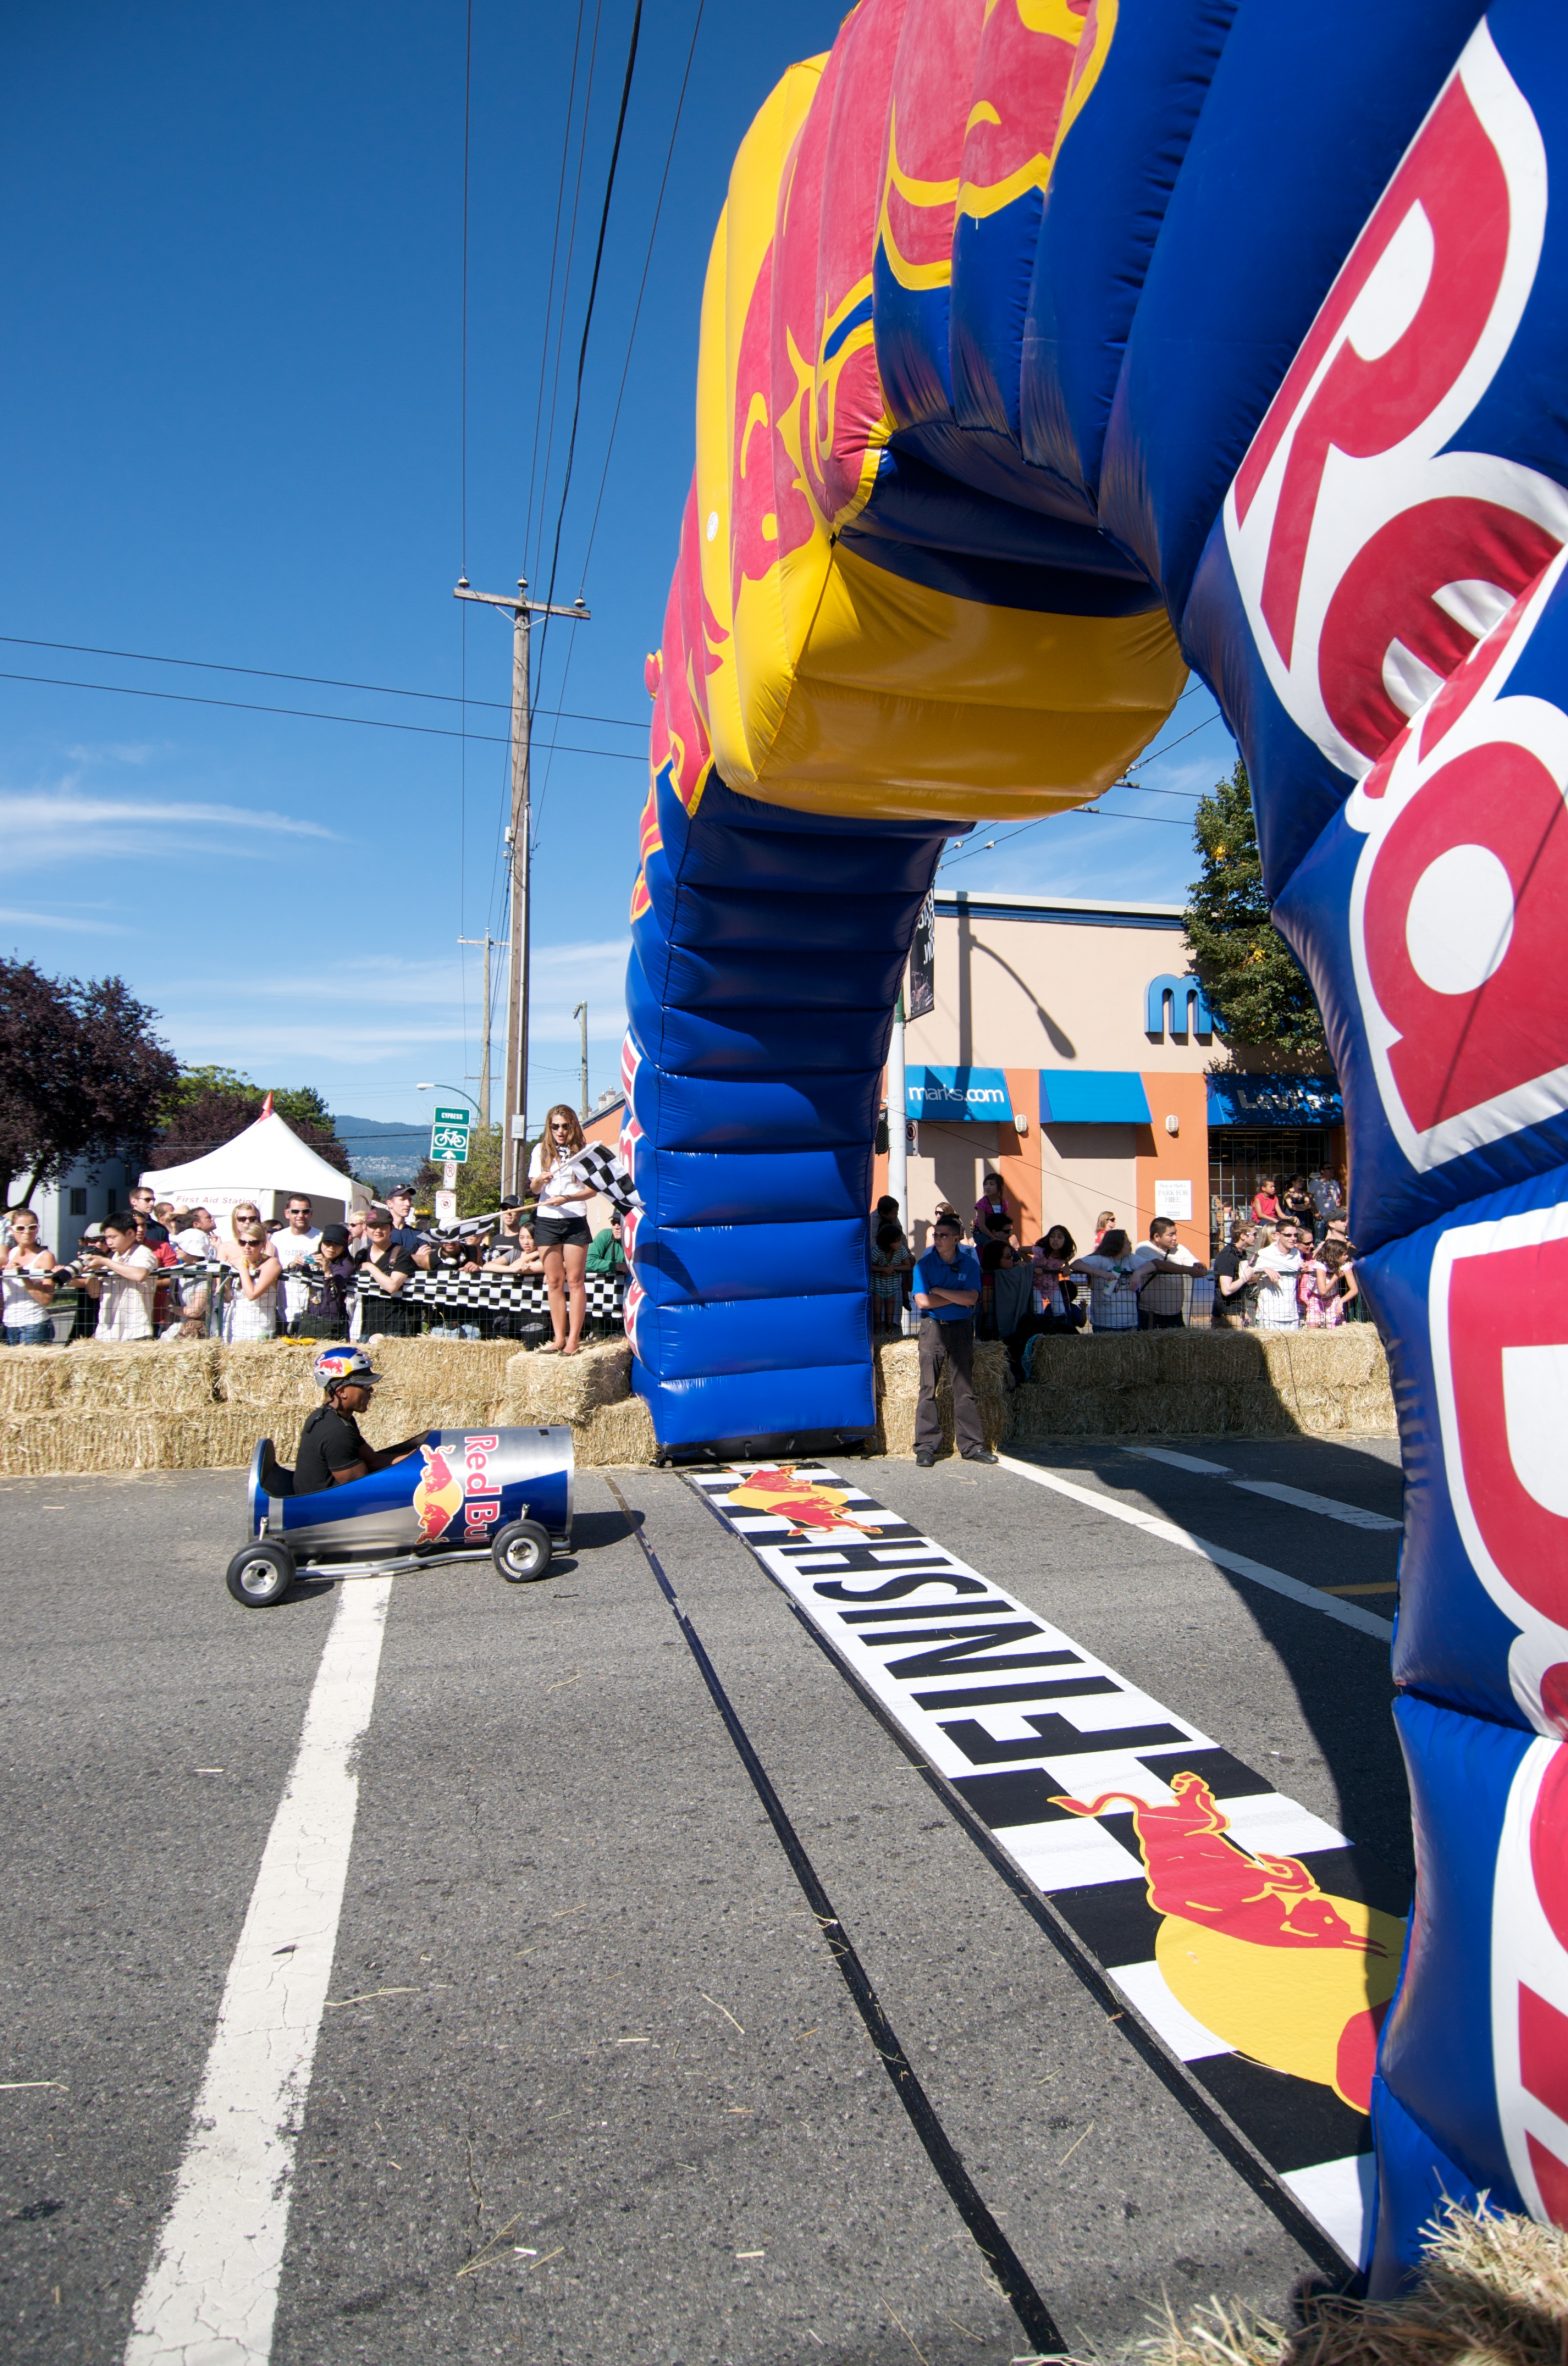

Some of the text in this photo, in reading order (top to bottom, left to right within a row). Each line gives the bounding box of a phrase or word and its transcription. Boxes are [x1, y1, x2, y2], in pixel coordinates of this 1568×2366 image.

[908, 1084, 1005, 1103] marks.com
[441, 1112, 464, 1120] CYPRESS
[176, 1195, 199, 1203] First
[202, 1196, 219, 1204] Aid
[465, 1434, 502, 1497] Red
[782, 1538, 1193, 1766] FINISH
